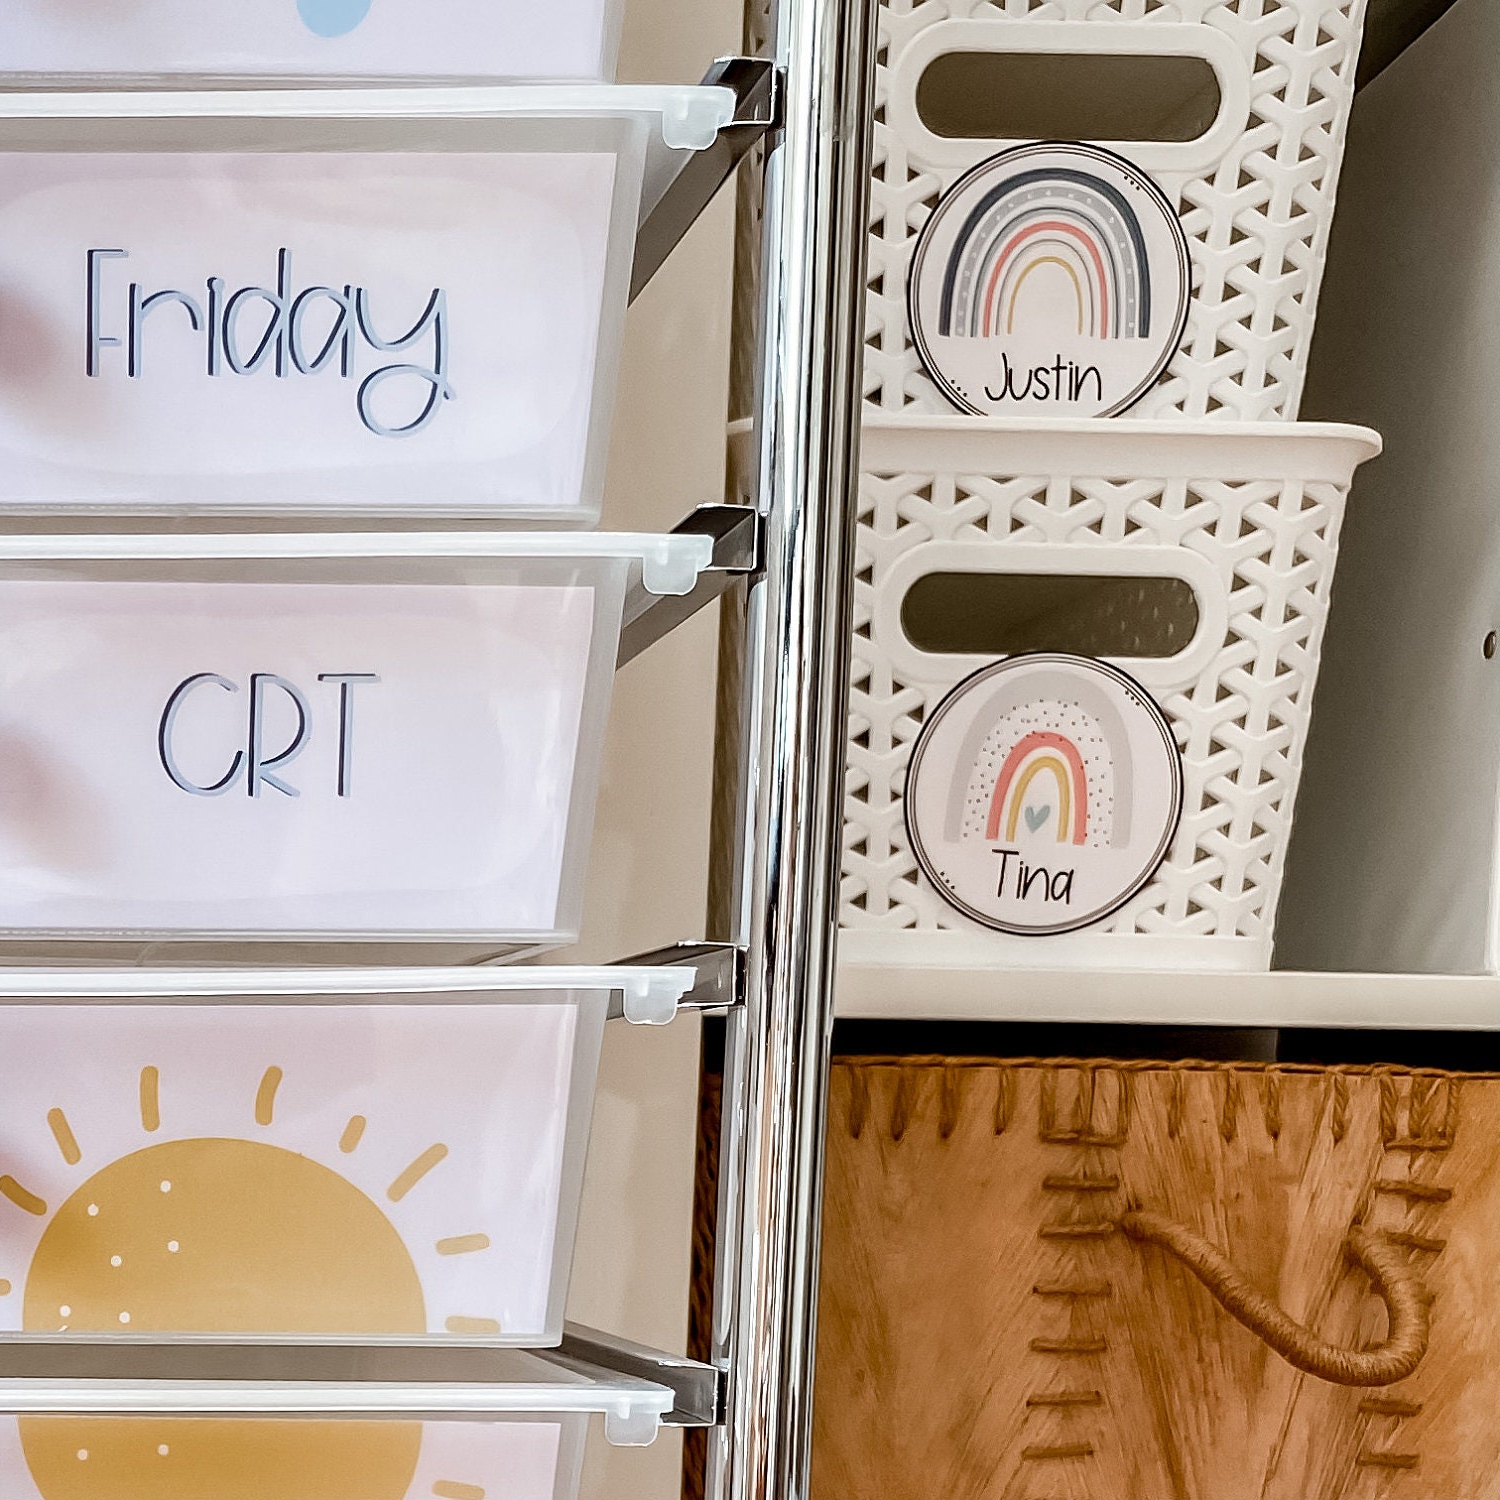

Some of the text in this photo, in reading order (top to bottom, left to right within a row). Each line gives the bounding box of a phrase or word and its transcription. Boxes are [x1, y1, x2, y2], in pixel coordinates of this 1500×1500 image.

[84, 246, 458, 437] Friday
[983, 351, 1103, 406] Justin
[157, 671, 381, 799] CRT
[990, 848, 1076, 907] Tina
